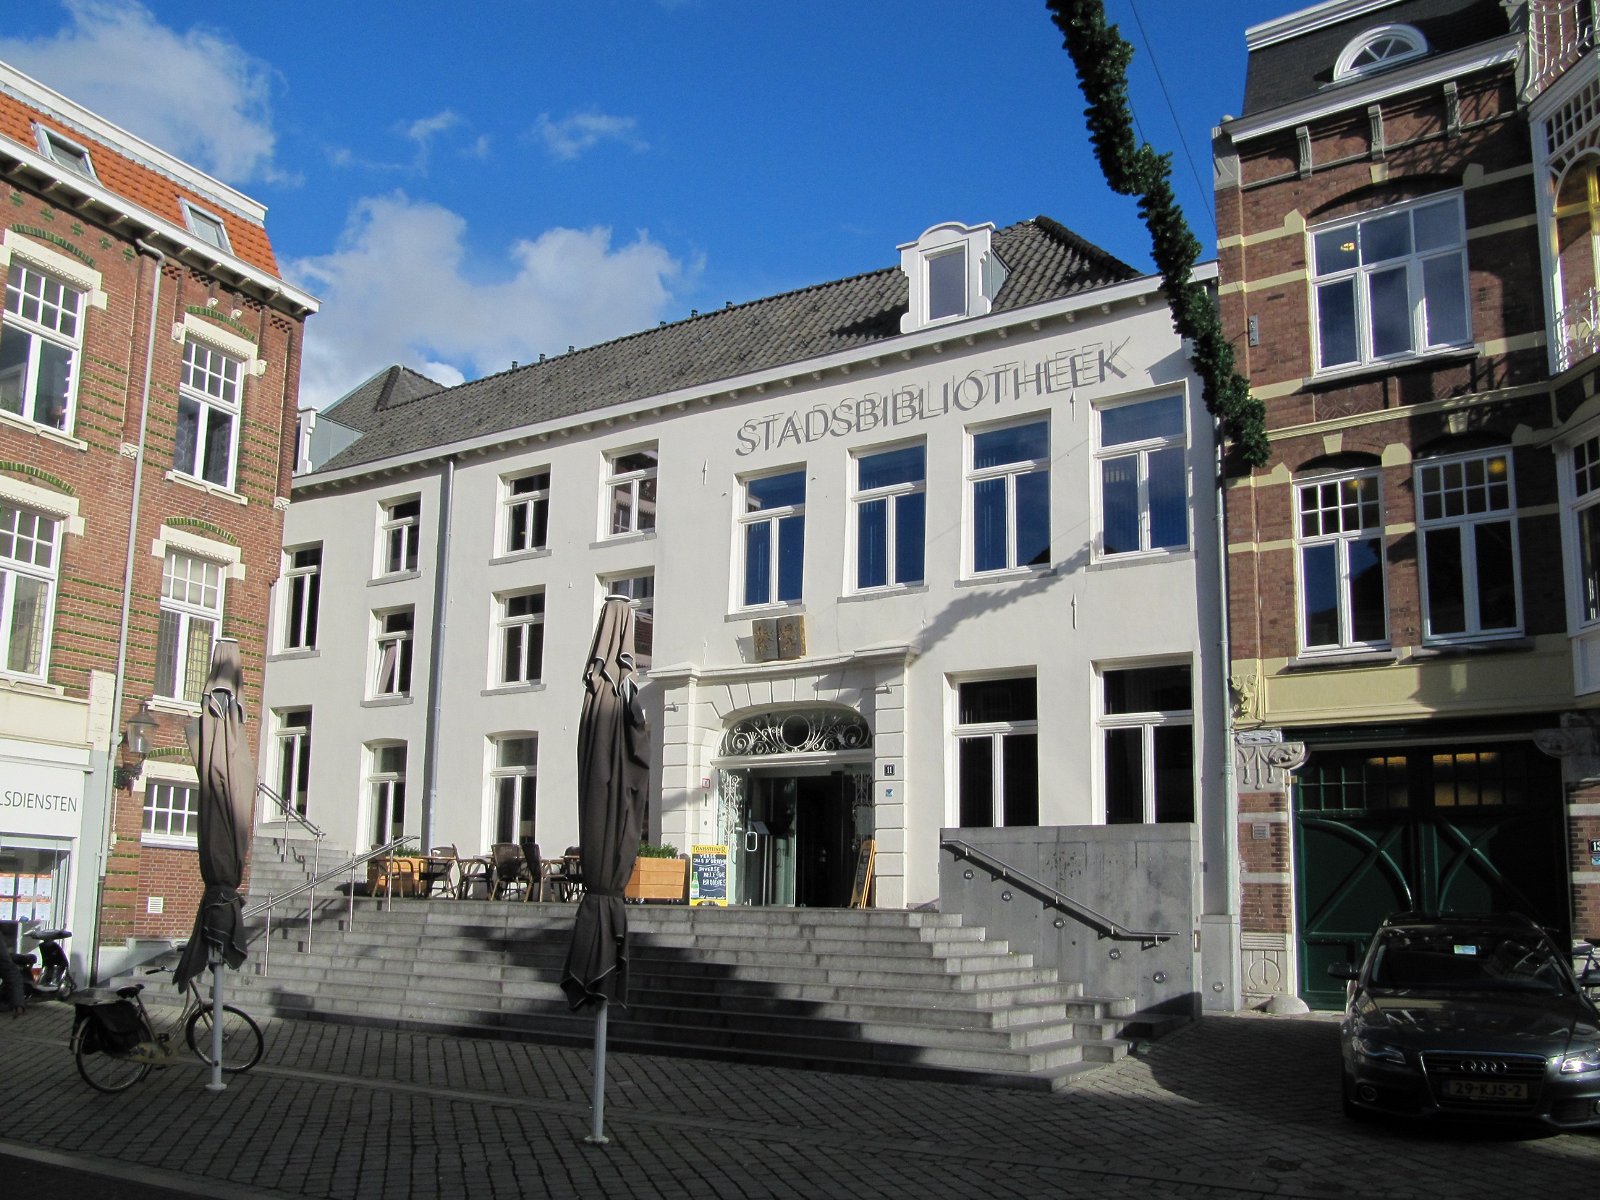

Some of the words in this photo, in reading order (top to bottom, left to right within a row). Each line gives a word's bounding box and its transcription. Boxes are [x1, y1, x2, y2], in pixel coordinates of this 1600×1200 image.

[735, 336, 1134, 457] STADSBIBLIOTHEEK
[0, 790, 78, 812] SDIENSTEN
[1455, 1082, 1522, 1097] 29-KJS-2
